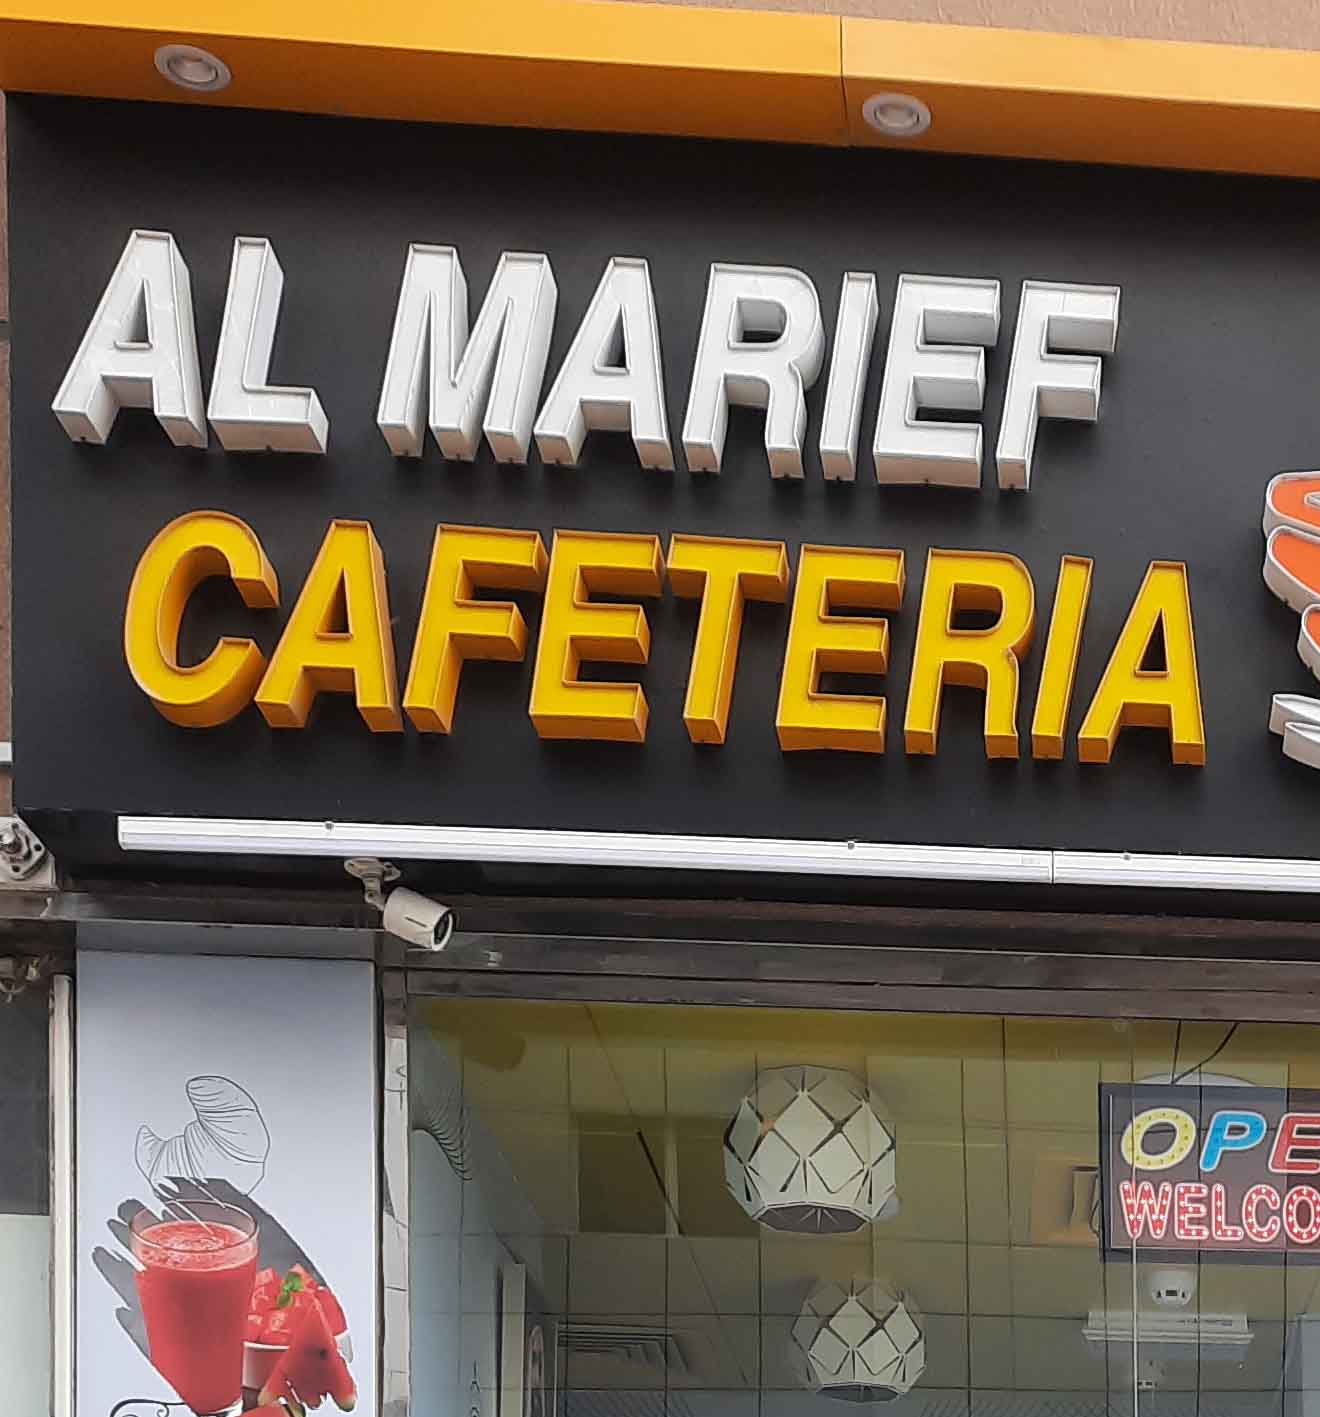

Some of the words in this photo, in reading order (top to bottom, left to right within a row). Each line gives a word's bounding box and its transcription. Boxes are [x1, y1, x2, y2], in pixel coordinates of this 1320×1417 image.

[51, 228, 329, 455] AL
[376, 241, 1122, 491] MARIEF
[123, 509, 1207, 768] CAFETERIA
